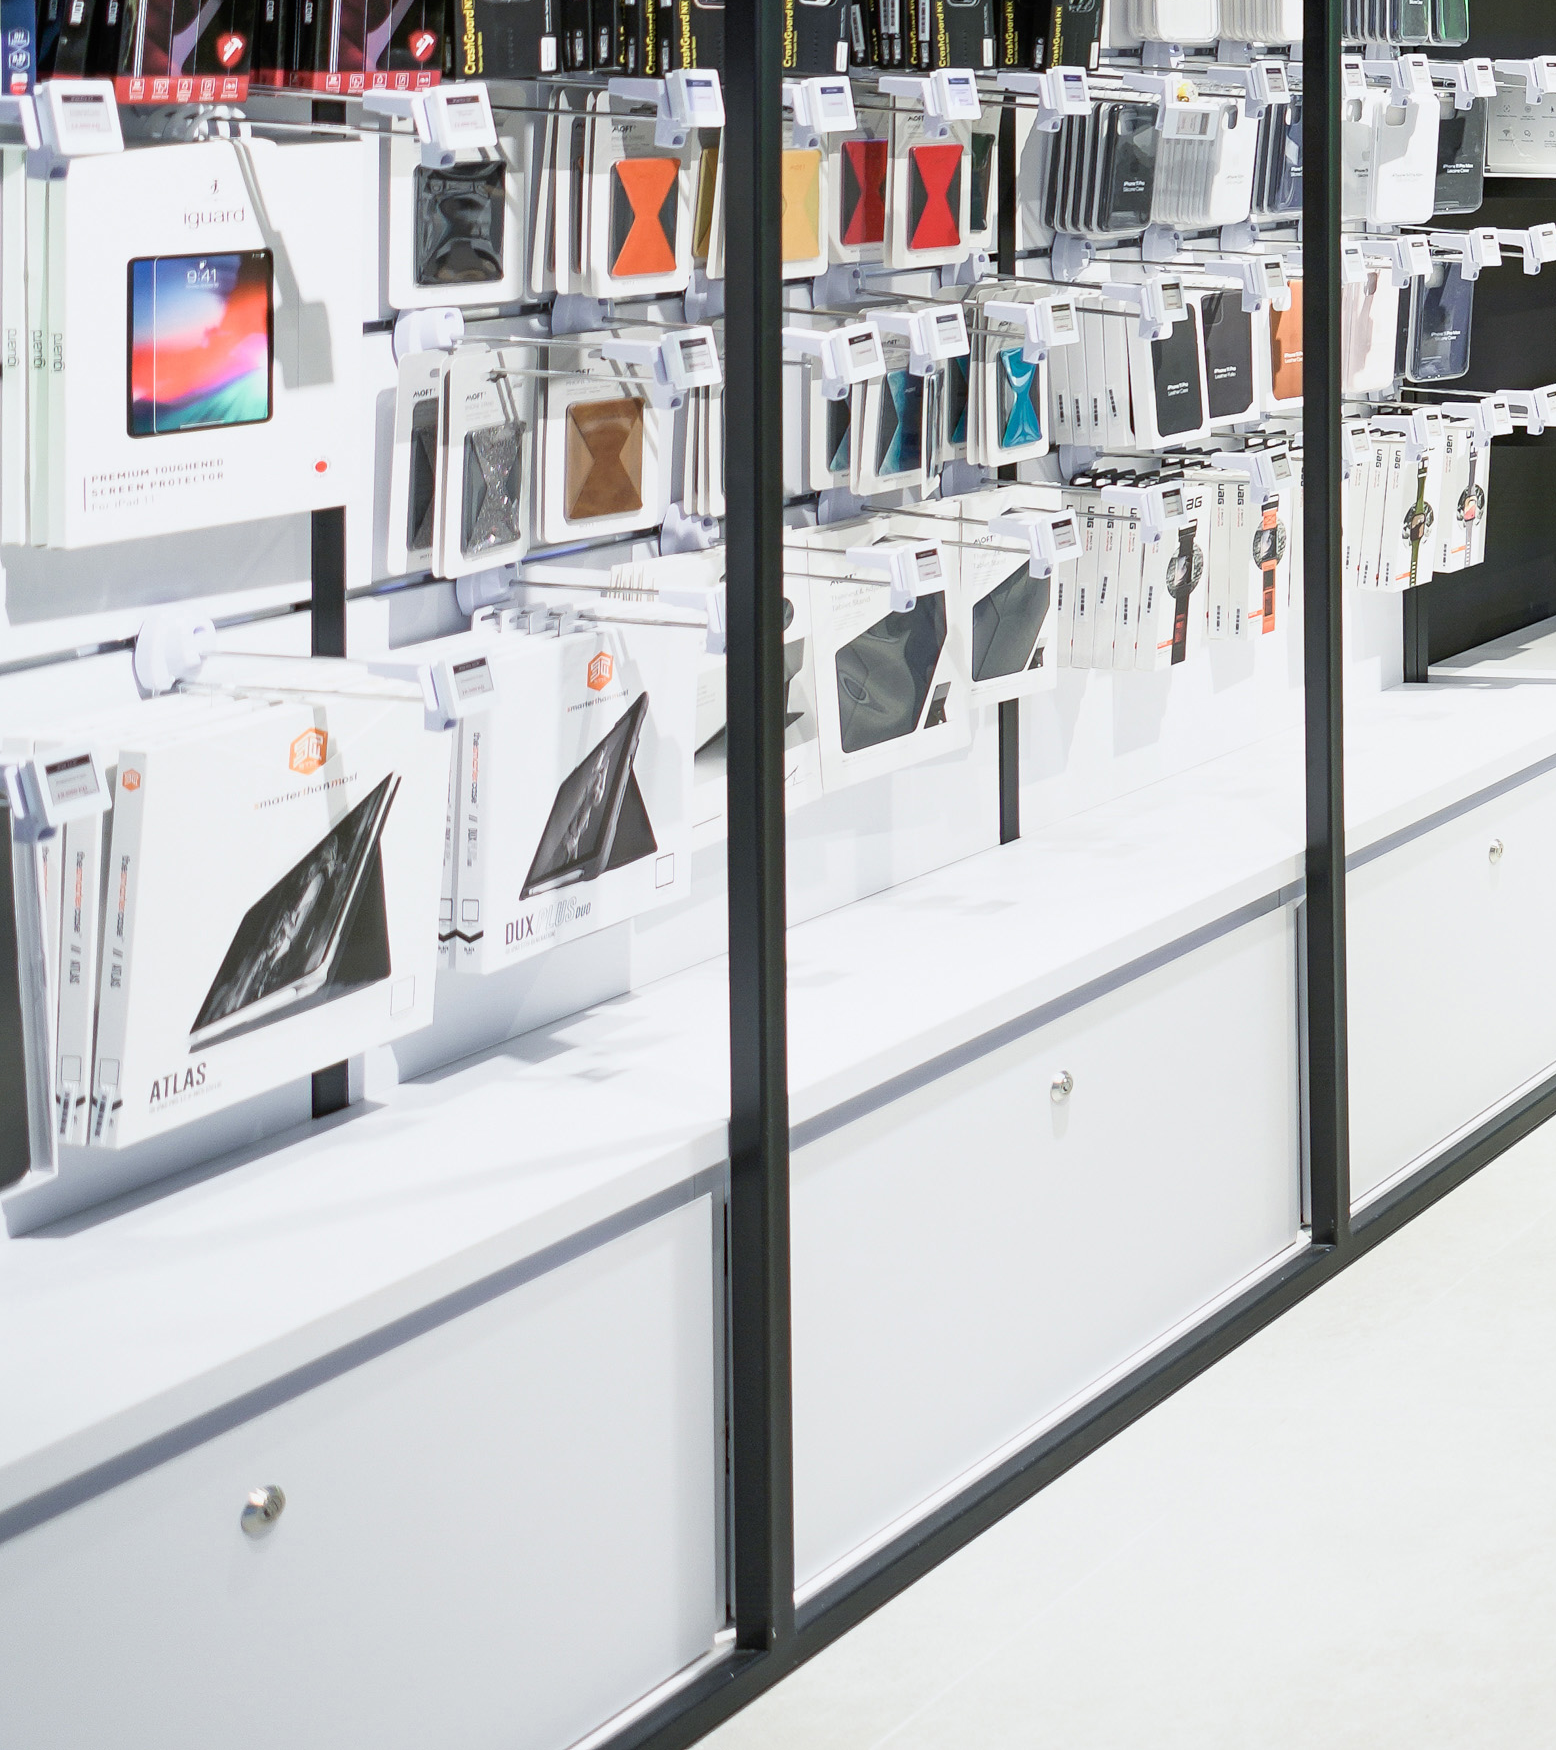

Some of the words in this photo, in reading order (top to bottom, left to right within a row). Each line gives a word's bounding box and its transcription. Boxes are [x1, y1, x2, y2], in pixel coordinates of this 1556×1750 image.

[936, 0, 944, 14] NX
[1005, 0, 1014, 13] NX
[463, 10, 476, 75] CrashGuard
[782, 10, 795, 68] CrashGuard
[938, 13, 946, 68] CrashGuard
[1005, 13, 1016, 66] CrashGuard
[612, 123, 636, 134] MOFT
[183, 206, 246, 230] iguard
[186, 268, 218, 285] 9:41
[6, 328, 19, 368] iguard
[32, 330, 45, 370] iguard
[53, 332, 65, 374] iguard
[412, 387, 435, 399] MOFT
[465, 390, 487, 402] MOFT
[1167, 382, 1179, 391] iPhone
[91, 468, 151, 483] PREMIUM
[155, 458, 224, 475] TOUGHENED
[91, 482, 145, 497] SCREEN
[150, 472, 224, 490] PROTECTOR
[505, 914, 535, 946] DUX
[535, 897, 576, 933] PLUS
[575, 903, 591, 920] DUO
[150, 1063, 207, 1103] ATLAS
